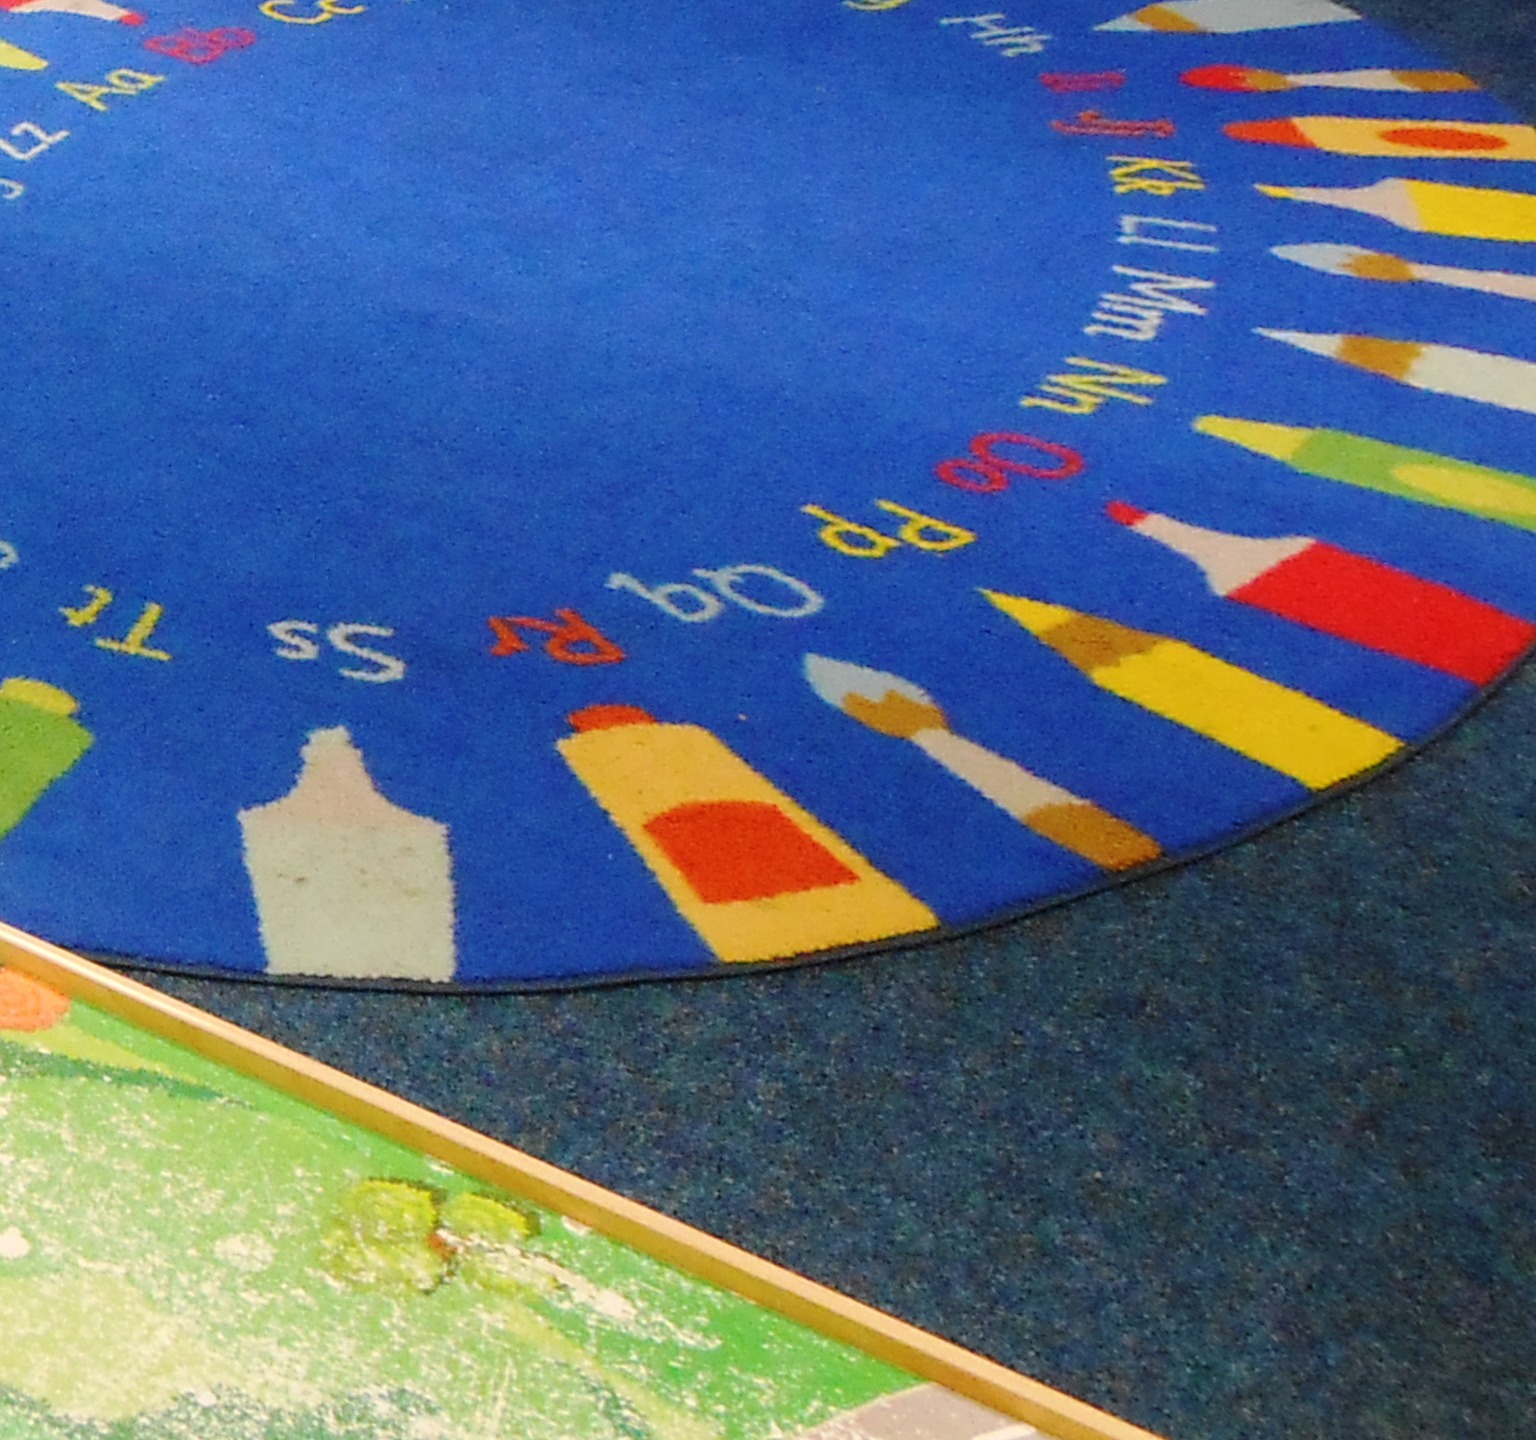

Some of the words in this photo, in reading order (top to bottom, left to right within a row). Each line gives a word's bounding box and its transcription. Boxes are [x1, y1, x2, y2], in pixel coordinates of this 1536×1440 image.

[147, 31, 252, 62] Bb
[941, 13, 1050, 57] Hh
[57, 68, 165, 111] Aa
[1111, 157, 1203, 195] Kk
[1084, 266, 1214, 340] Mm
[1021, 358, 1166, 414] Nn
[937, 433, 1083, 492] Oo
[802, 500, 975, 557] Pp
[607, 564, 824, 622] Qq
[60, 585, 171, 661] Tt
[490, 609, 624, 663] Rr
[268, 621, 405, 682] Ss
